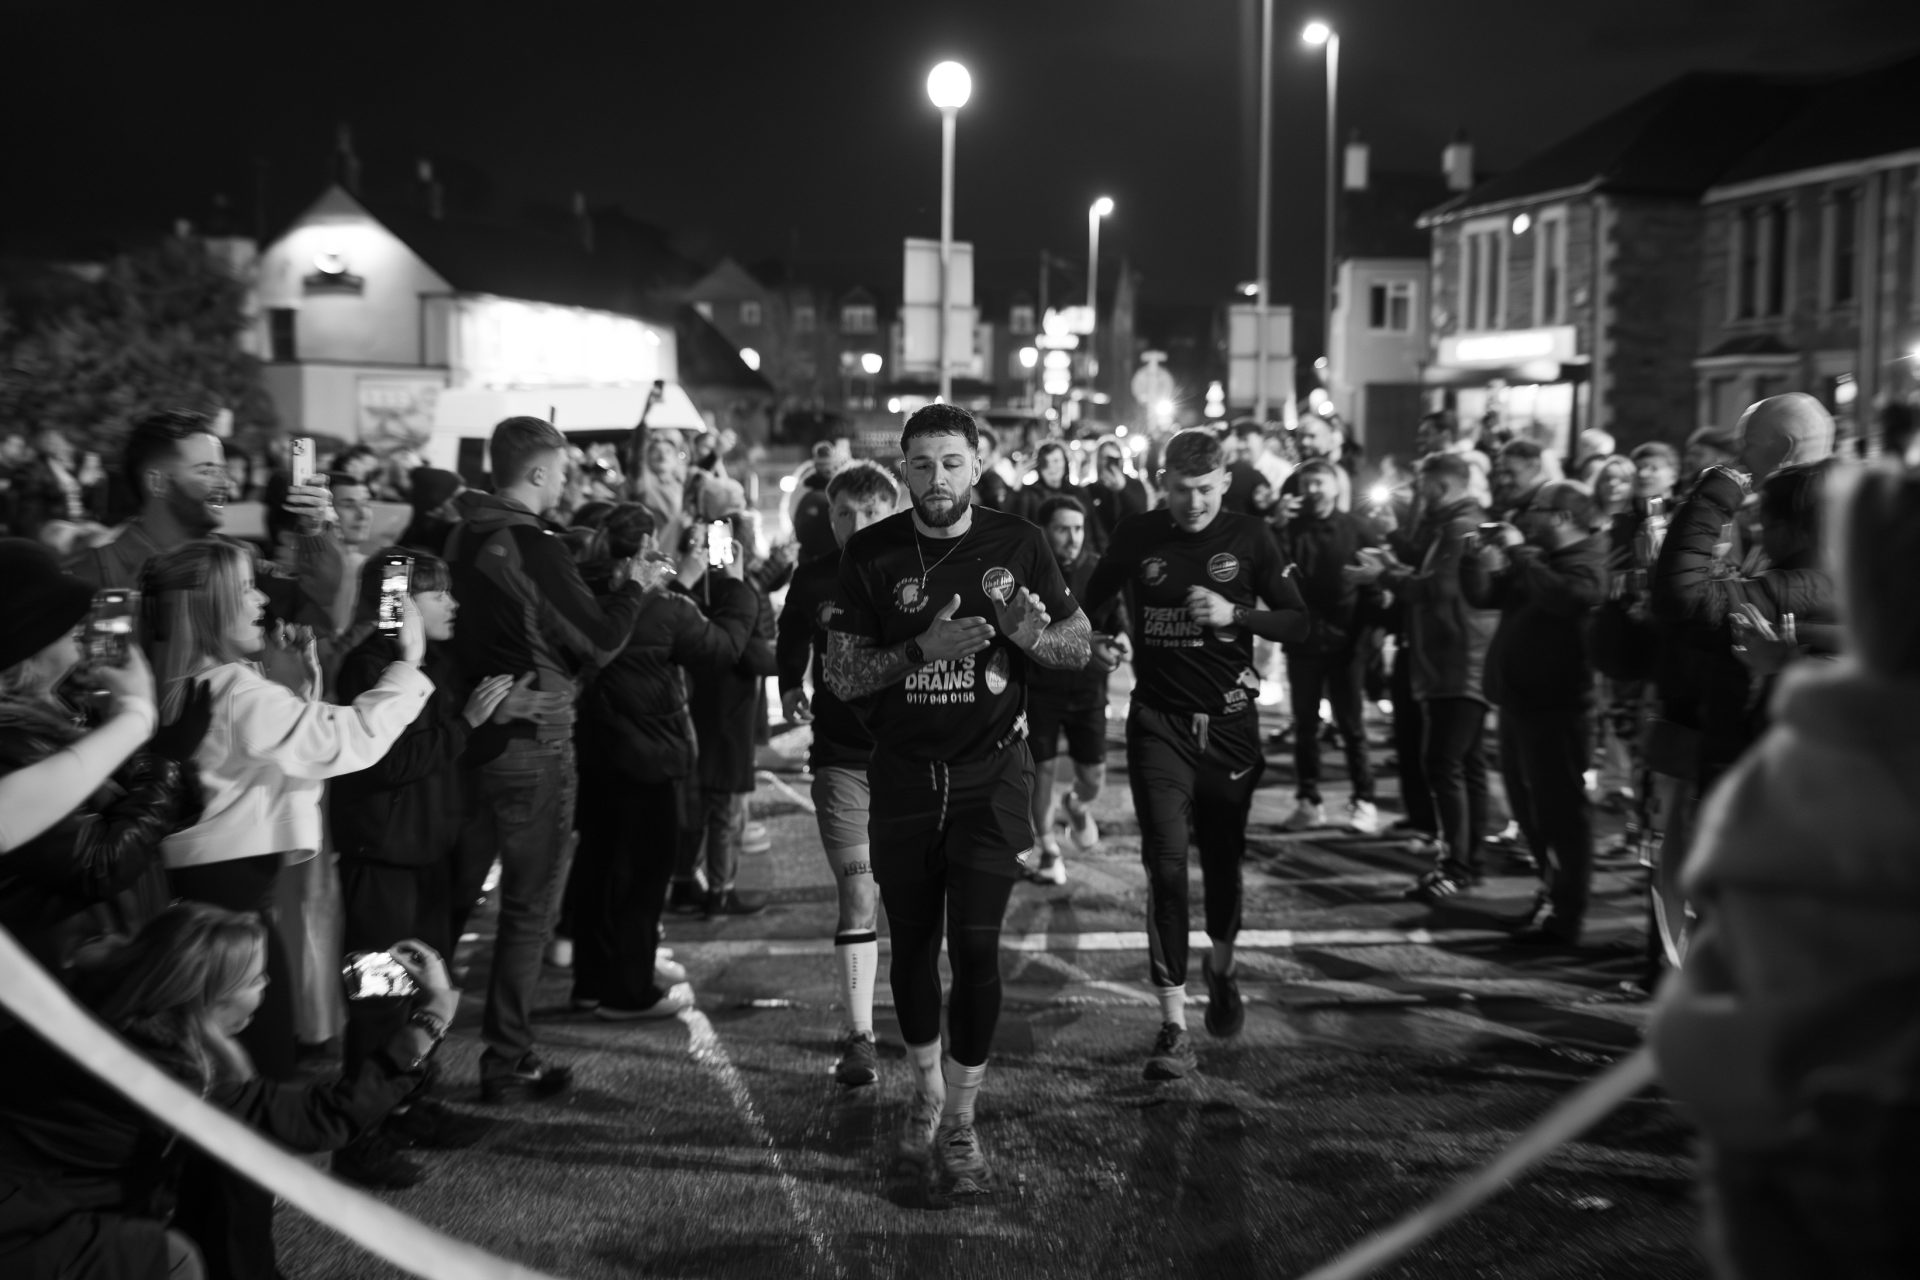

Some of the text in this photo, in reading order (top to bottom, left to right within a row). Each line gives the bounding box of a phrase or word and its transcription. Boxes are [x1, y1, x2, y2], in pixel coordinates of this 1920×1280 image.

[1144, 619, 1203, 637] DRAINS
[918, 653, 976, 674] ENT'S
[904, 669, 976, 691] DRAINS
[906, 692, 928, 704] 0117
